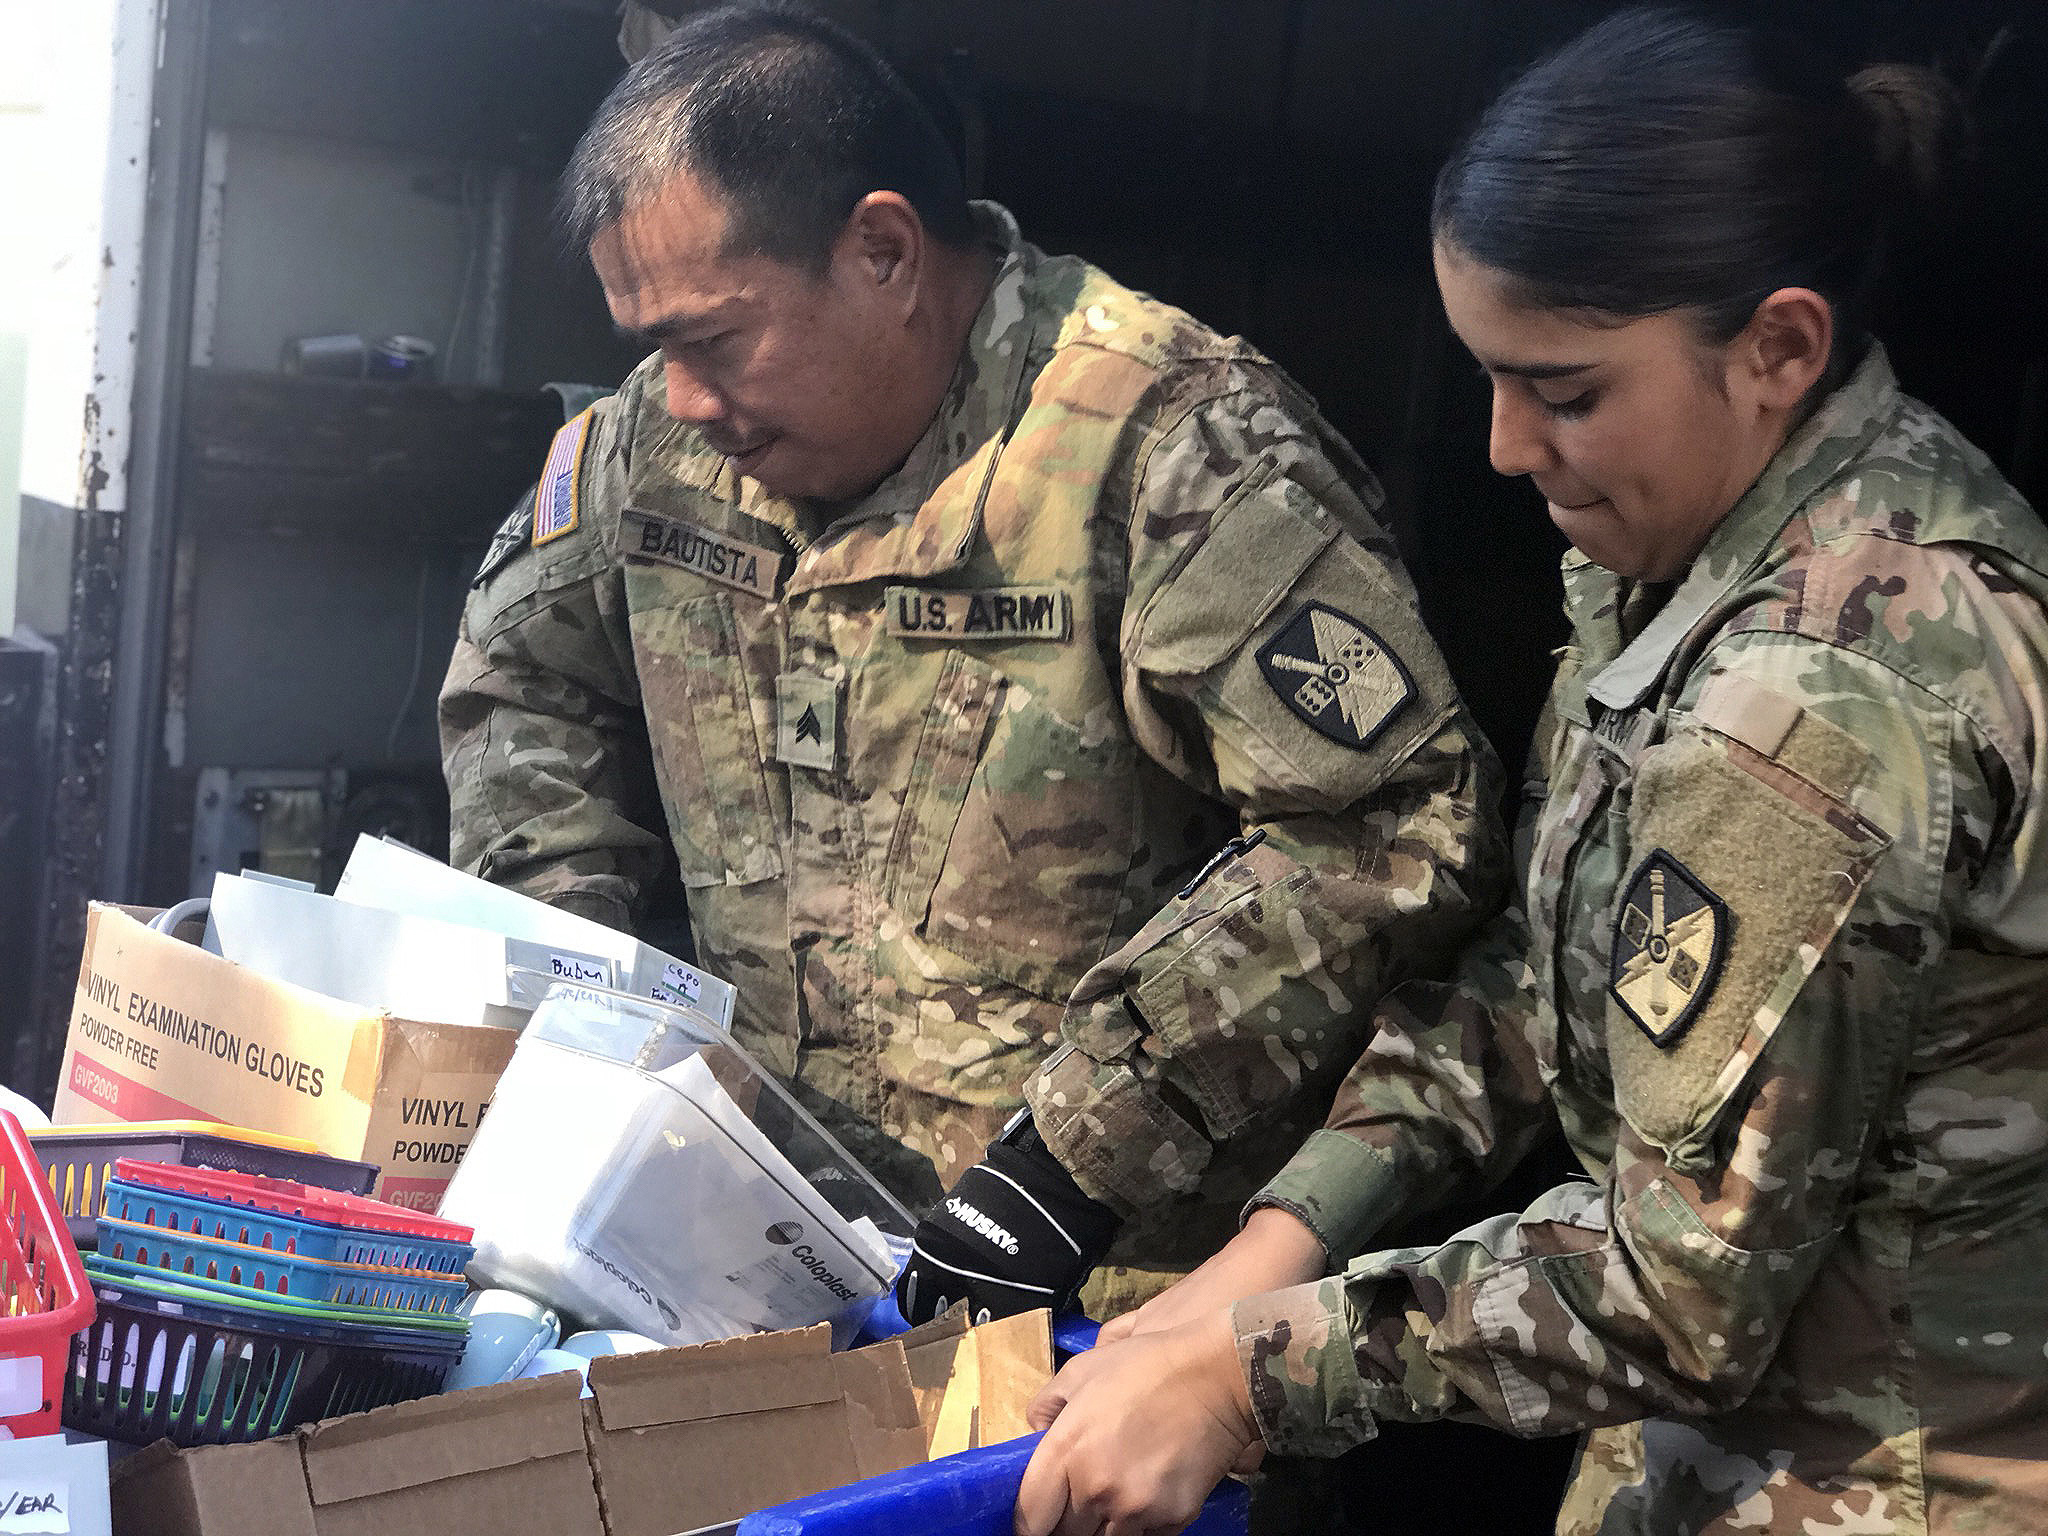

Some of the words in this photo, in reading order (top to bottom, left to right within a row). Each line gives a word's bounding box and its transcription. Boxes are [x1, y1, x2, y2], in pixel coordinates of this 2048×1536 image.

[640, 521, 758, 588] BAUTISTA
[899, 594, 953, 632] U.S.
[963, 593, 1055, 633] ARMY
[79, 1013, 123, 1055] POWDER
[125, 1038, 159, 1071] FREE
[87, 969, 121, 1014] VINYL
[127, 992, 241, 1065] EXAMINATION
[245, 1043, 325, 1098] GLOVES
[73, 1064, 119, 1105] GVF2003
[402, 1098, 468, 1128] VINYL
[392, 1140, 469, 1164] POWDE
[791, 1245, 859, 1301] Coloplast
[0, 1490, 63, 1520] /EAR
